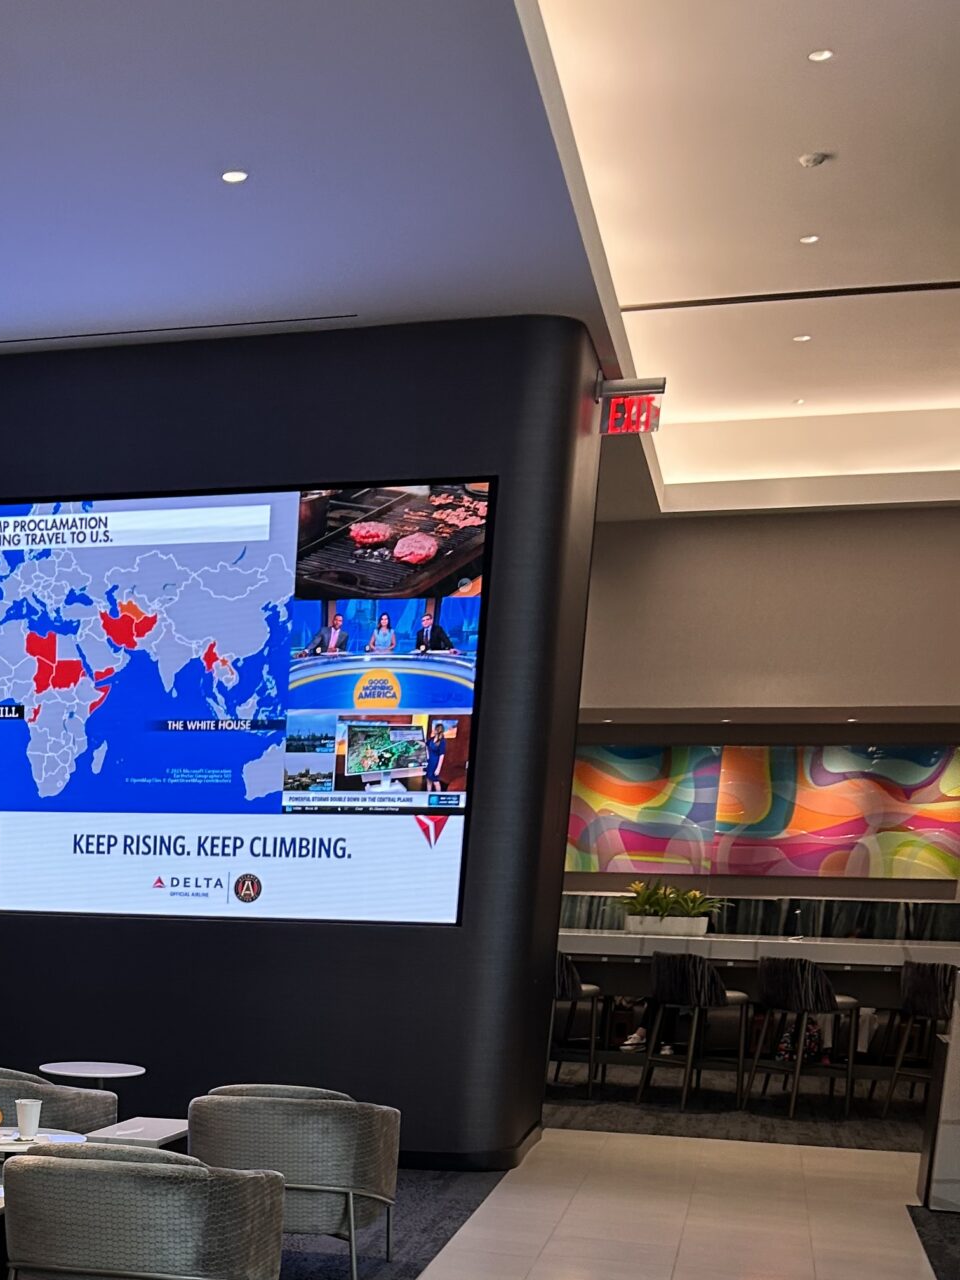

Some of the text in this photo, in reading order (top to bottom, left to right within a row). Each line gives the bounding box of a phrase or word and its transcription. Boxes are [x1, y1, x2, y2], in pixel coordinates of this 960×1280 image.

[608, 396, 655, 434] EXIT
[13, 516, 108, 532] PROCLAMATION
[25, 532, 66, 545] TRAVEL
[71, 531, 86, 543] TO
[90, 530, 113, 543] U.S.
[358, 691, 397, 699] AMERICA
[167, 719, 251, 731] THE WHITE HOUSE
[73, 834, 352, 859] KEEP RISING. KEEP CLIMBING.
[170, 877, 224, 888] DELTA
